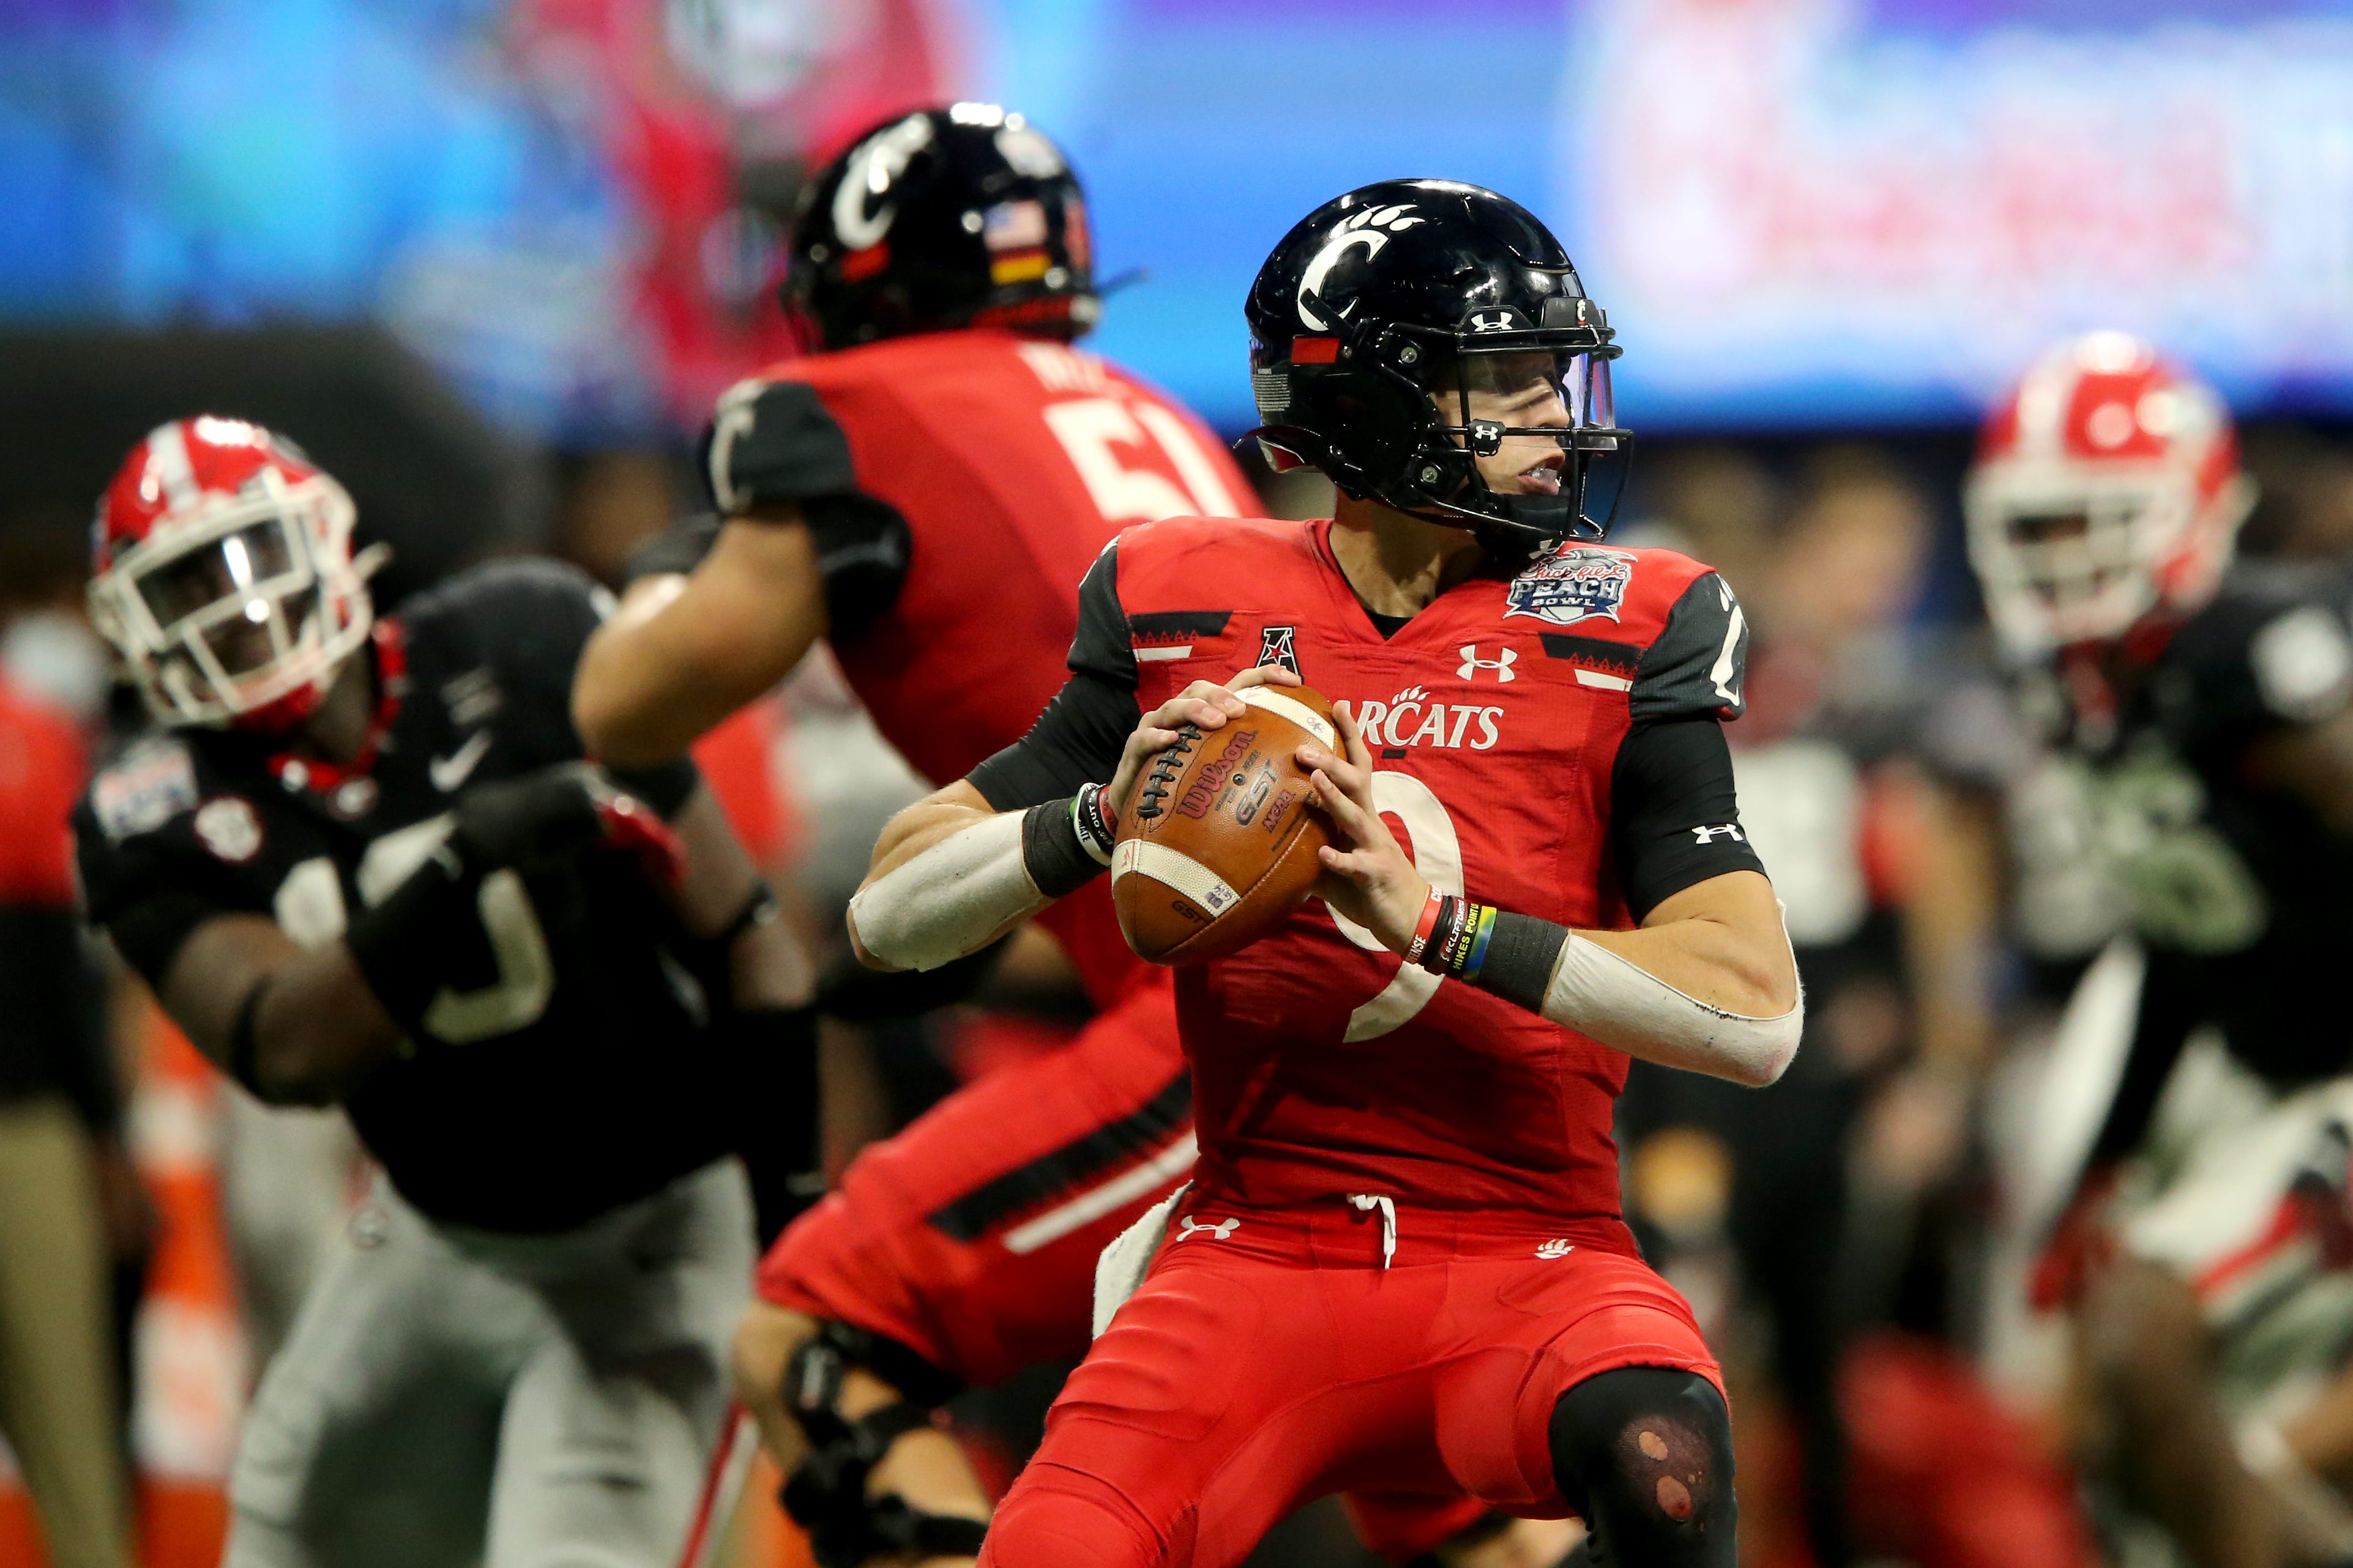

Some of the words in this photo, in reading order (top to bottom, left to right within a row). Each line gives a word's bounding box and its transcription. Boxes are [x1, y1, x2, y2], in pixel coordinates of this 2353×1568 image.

[1042, 396, 1242, 523] 51
[1510, 579, 1623, 603] PEACH
[1531, 596, 1597, 608] BOWL
[1176, 730, 1256, 819] Wilson
[1235, 766, 1278, 826] GST
[1262, 789, 1295, 833] NCAA
[1172, 900, 1209, 926] GST
[1453, 935, 1471, 970] HIKES
